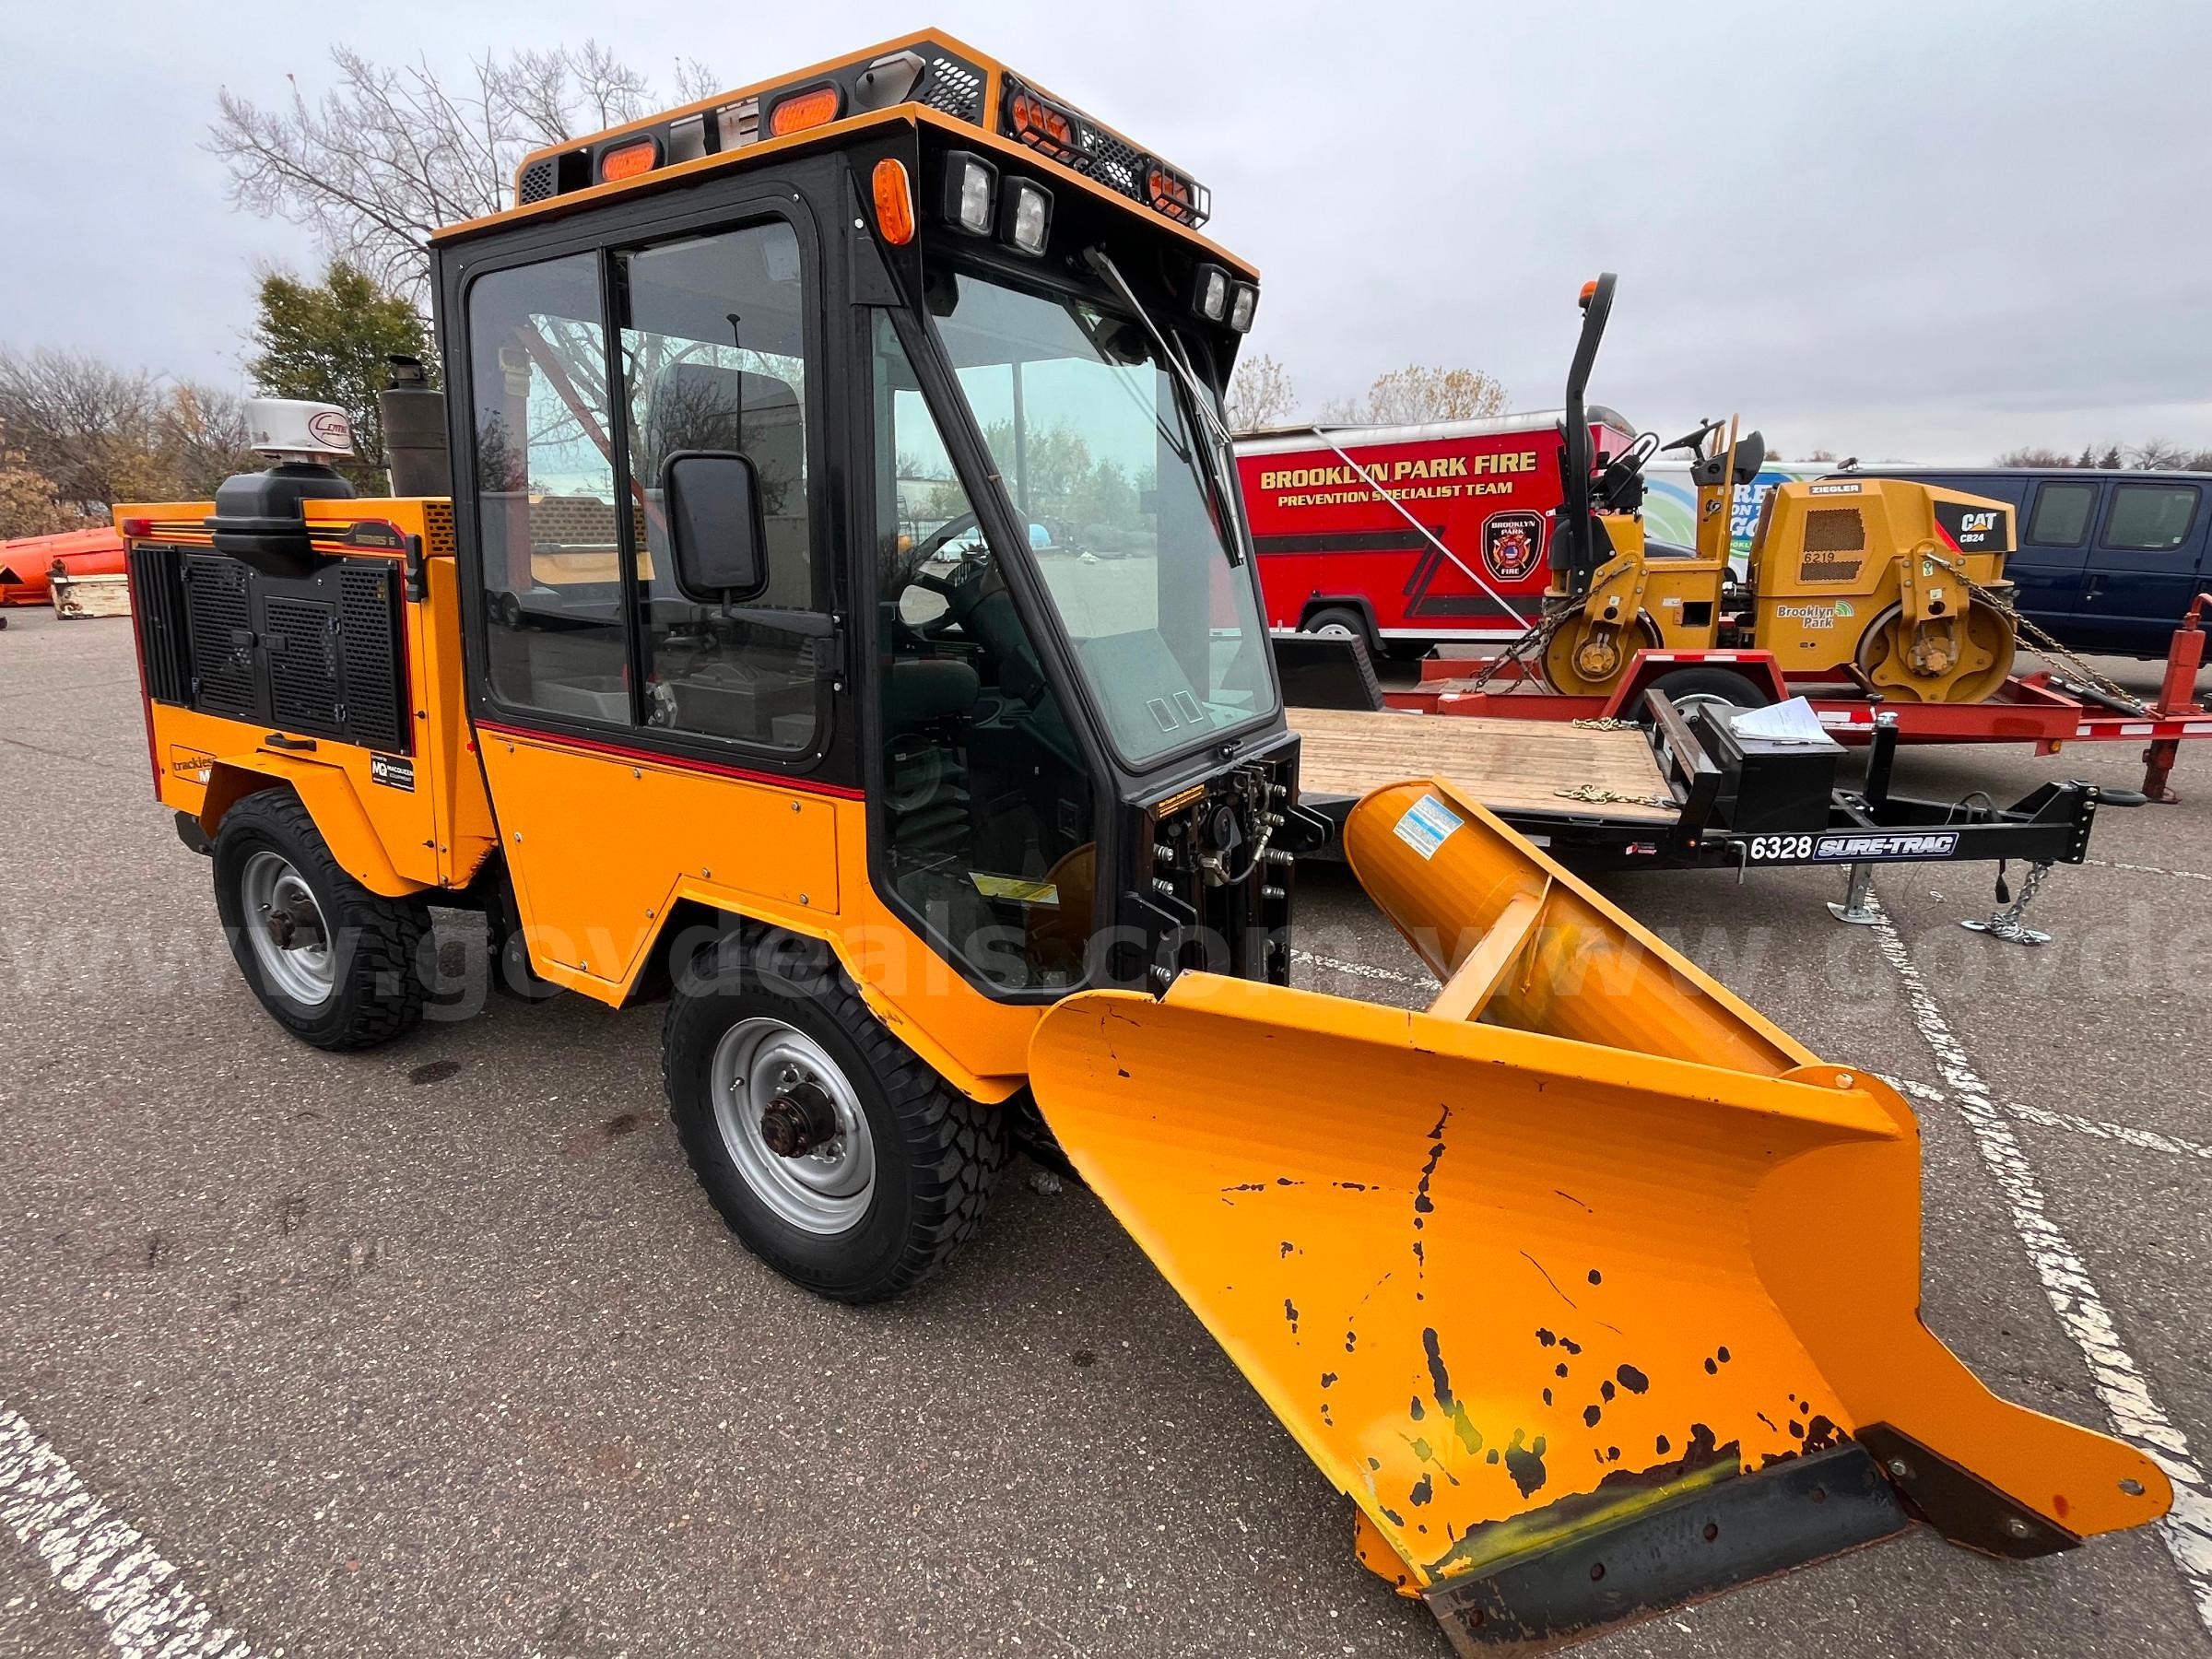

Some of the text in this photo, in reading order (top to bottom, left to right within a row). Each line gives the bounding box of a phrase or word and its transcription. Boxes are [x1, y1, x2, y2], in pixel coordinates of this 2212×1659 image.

[1261, 452, 1536, 489] BROOKLYN PARK FIRE
[1277, 481, 1513, 507] PREVENTION SPECIALIST TEAM
[1812, 485, 1859, 493] ZIEGLER
[1491, 521, 1535, 529] BROOKLYN
[1961, 512, 1997, 532] CAT
[1959, 534, 1984, 543] CB24
[1804, 553, 1835, 563] 6219
[1777, 605, 1834, 619] Brooklyn
[1803, 617, 1834, 628] Park
[1751, 836, 1953, 860] 6328 SURE-TRAC
